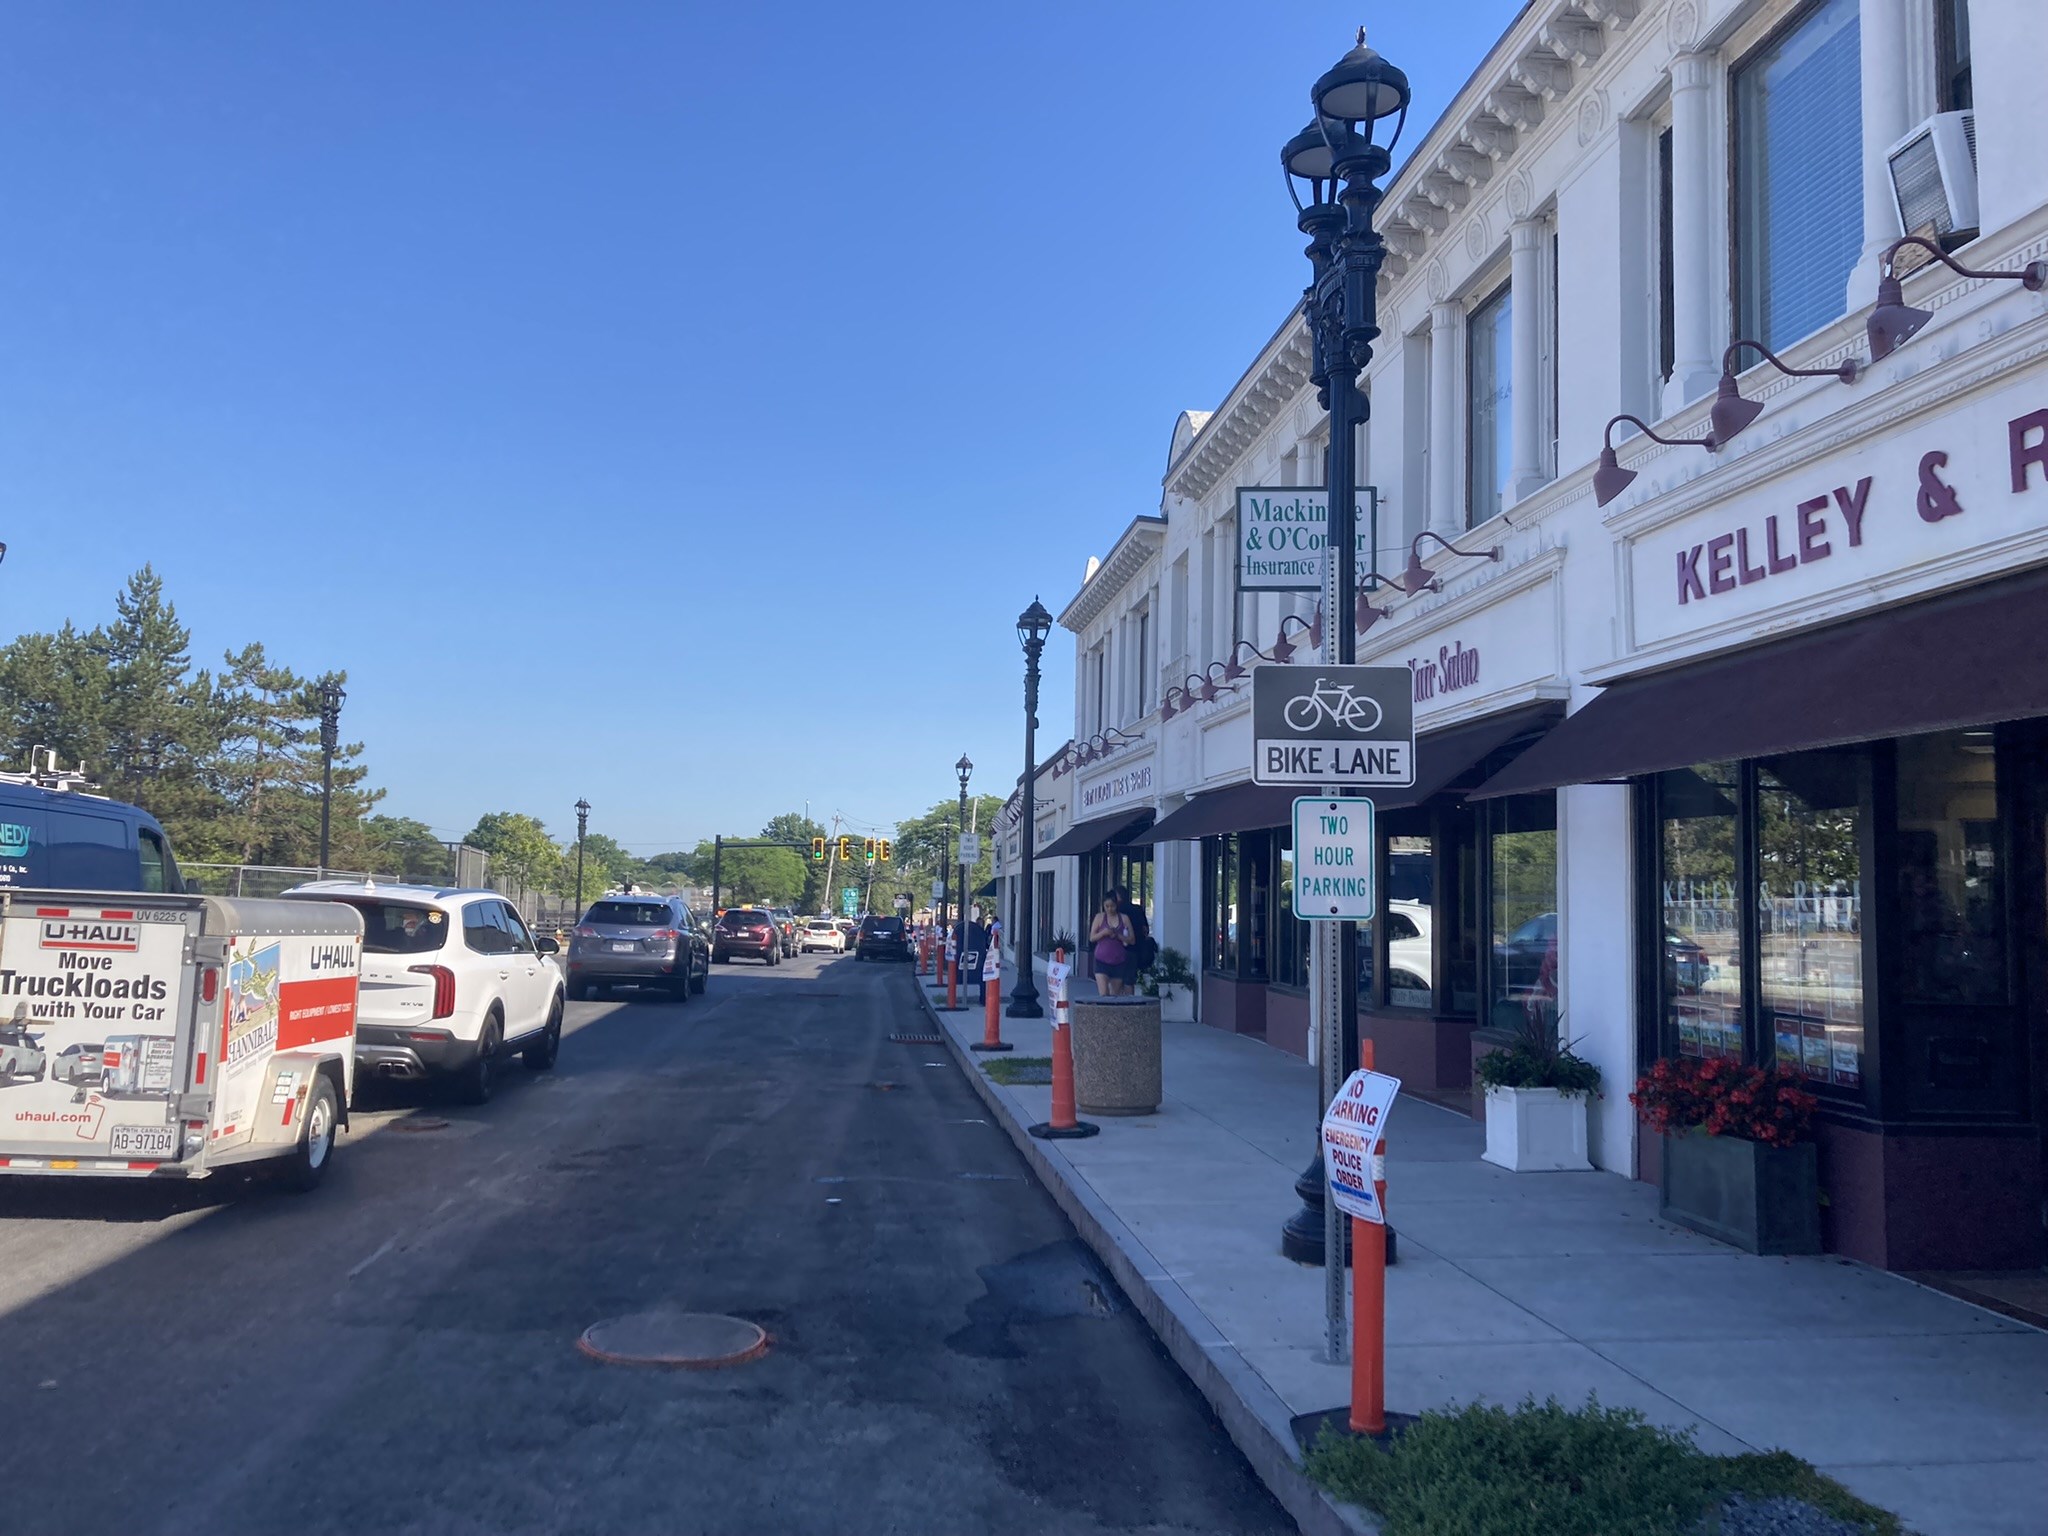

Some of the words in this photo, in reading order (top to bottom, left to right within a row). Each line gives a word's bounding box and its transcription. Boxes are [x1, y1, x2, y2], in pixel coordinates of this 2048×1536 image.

[1676, 476, 1872, 604] KELLEY
[1917, 451, 1963, 523] &
[1246, 527, 1262, 551] &
[1246, 555, 1314, 575] Insurance
[1439, 640, 1479, 693] Salon
[1267, 747, 1323, 773] BIKE
[1335, 748, 1401, 774] LANE
[1320, 816, 1348, 835] TWO
[1314, 847, 1354, 866] HOUR
[1302, 877, 1366, 897] PARKING
[137, 911, 149, 921] UV
[153, 912, 176, 922] 6225
[180, 912, 187, 922] C
[45, 924, 135, 942] U-HAUL
[58, 952, 113, 970] Move
[310, 945, 354, 969] U-HAUL
[0, 970, 167, 1000] Truckloads
[32, 1001, 75, 1018] with
[82, 1002, 125, 1019] Your
[132, 1003, 165, 1020] Car
[1347, 1079, 1364, 1099] NO
[15, 1112, 91, 1123] uhaul.com
[1330, 1102, 1379, 1126] PARKING
[113, 1134, 172, 1150] AB-97184
[1326, 1129, 1372, 1154] EMERGENCY
[1333, 1149, 1362, 1171] POLICE
[1336, 1169, 1364, 1191] ORDER
